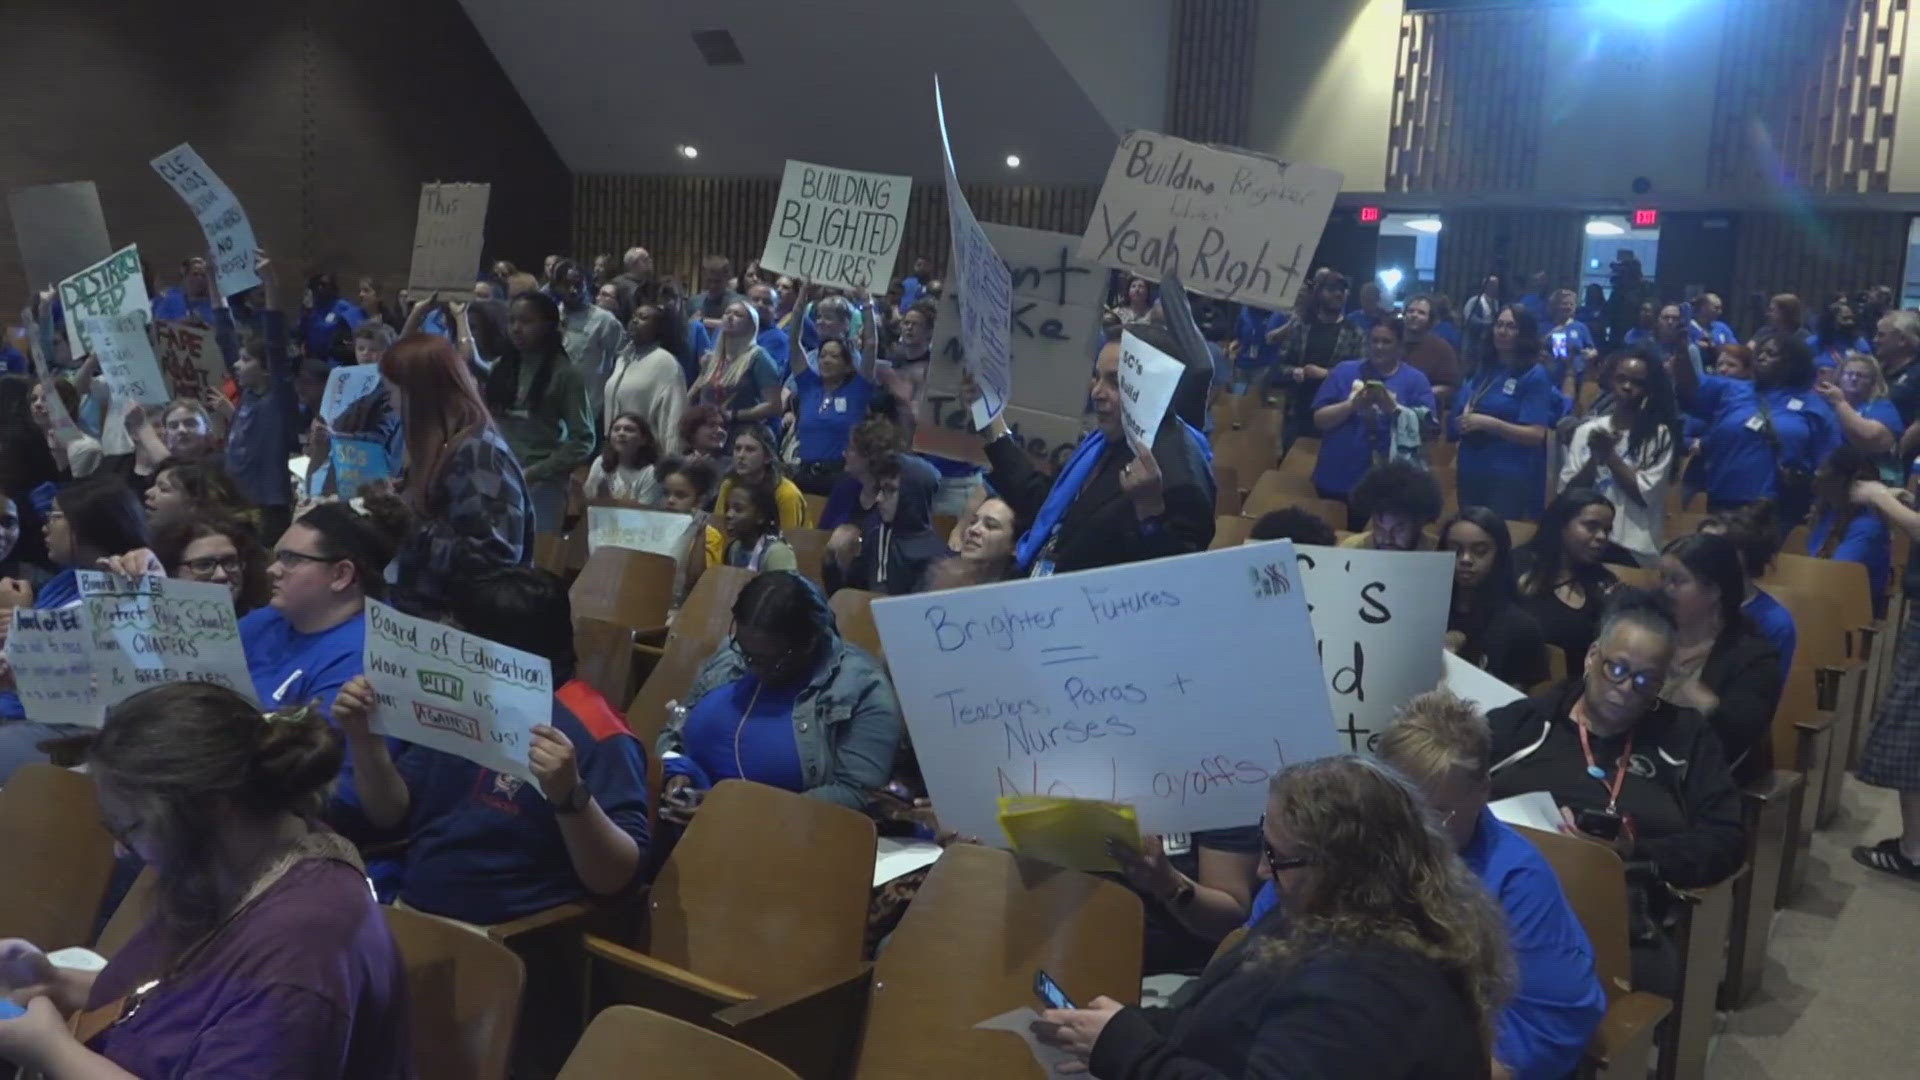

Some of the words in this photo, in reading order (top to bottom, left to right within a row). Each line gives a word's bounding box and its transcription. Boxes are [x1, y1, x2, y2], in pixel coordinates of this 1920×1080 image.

[801, 168, 892, 209] BUILDING
[779, 200, 899, 256] BLIGHTED
[1362, 208, 1378, 221] EXIT
[1635, 210, 1656, 224] EXIT
[783, 243, 876, 288] FUTURES
[1098, 203, 1179, 275] Yeah
[1190, 227, 1303, 299] Right
[370, 605, 418, 648] Board
[430, 631, 449, 656] of
[925, 604, 1063, 652] Brighter
[1080, 585, 1181, 624] Futures
[1064, 676, 1147, 709] Paras
[1004, 714, 1137, 760] Nurses
